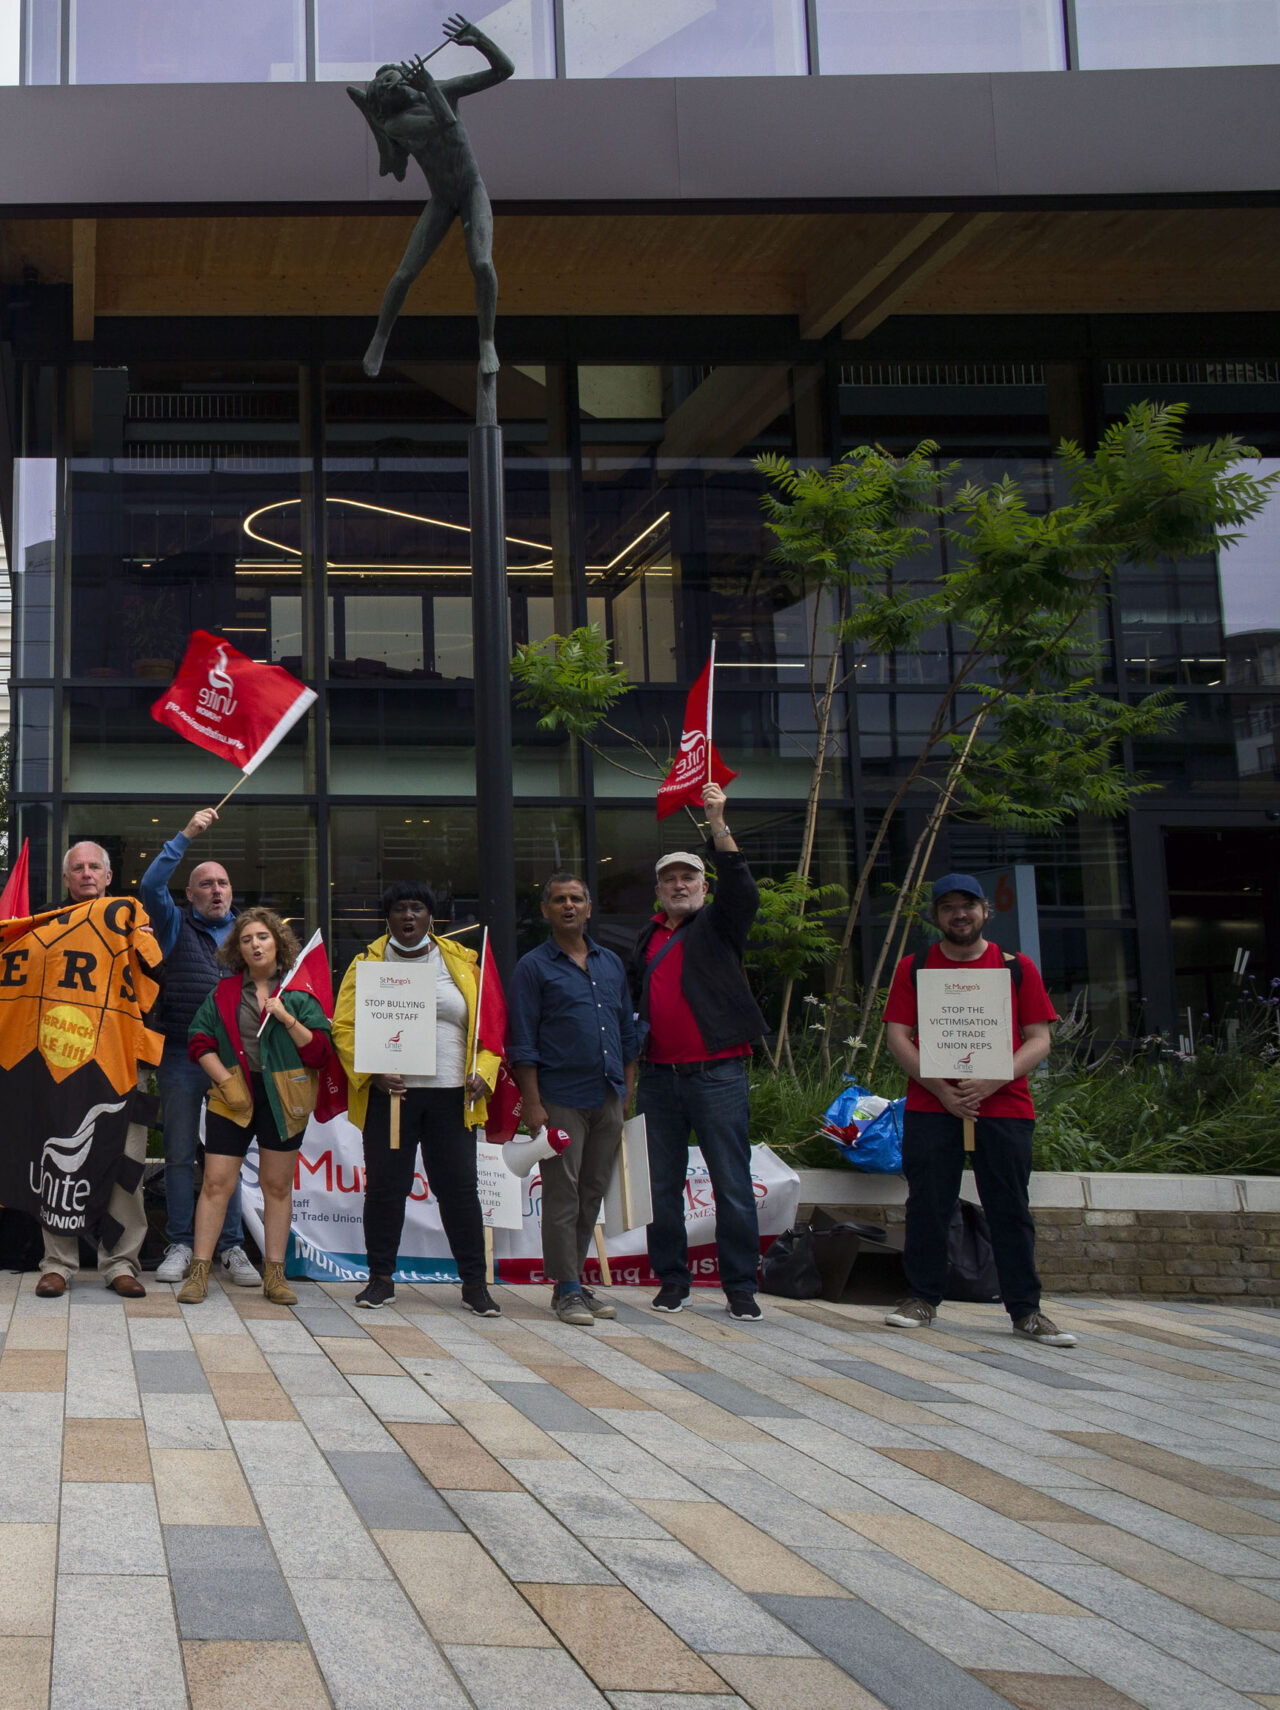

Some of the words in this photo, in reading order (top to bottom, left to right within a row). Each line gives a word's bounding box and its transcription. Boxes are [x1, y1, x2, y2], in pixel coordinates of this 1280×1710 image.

[995, 875, 1014, 913] 6
[365, 999, 385, 1007] STOP
[387, 1000, 425, 1009] BULLYING
[941, 1006, 965, 1014] STOP
[967, 1006, 985, 1014] THE
[371, 1012, 393, 1020] YOUR
[395, 1013, 419, 1021] STAFF
[43, 1014, 95, 1039] BRANCH
[930, 1018, 998, 1026] VICTIMISATION
[957, 1030, 986, 1038] TRADE
[43, 1034, 58, 1052] LE
[937, 1042, 968, 1050] UNION
[970, 1042, 992, 1050] REPS
[493, 1171, 506, 1179] THE
[30, 1161, 91, 1211] unite
[488, 1190, 502, 1198] THE
[301, 1211, 330, 1222] Trade
[332, 1213, 362, 1224] Union
